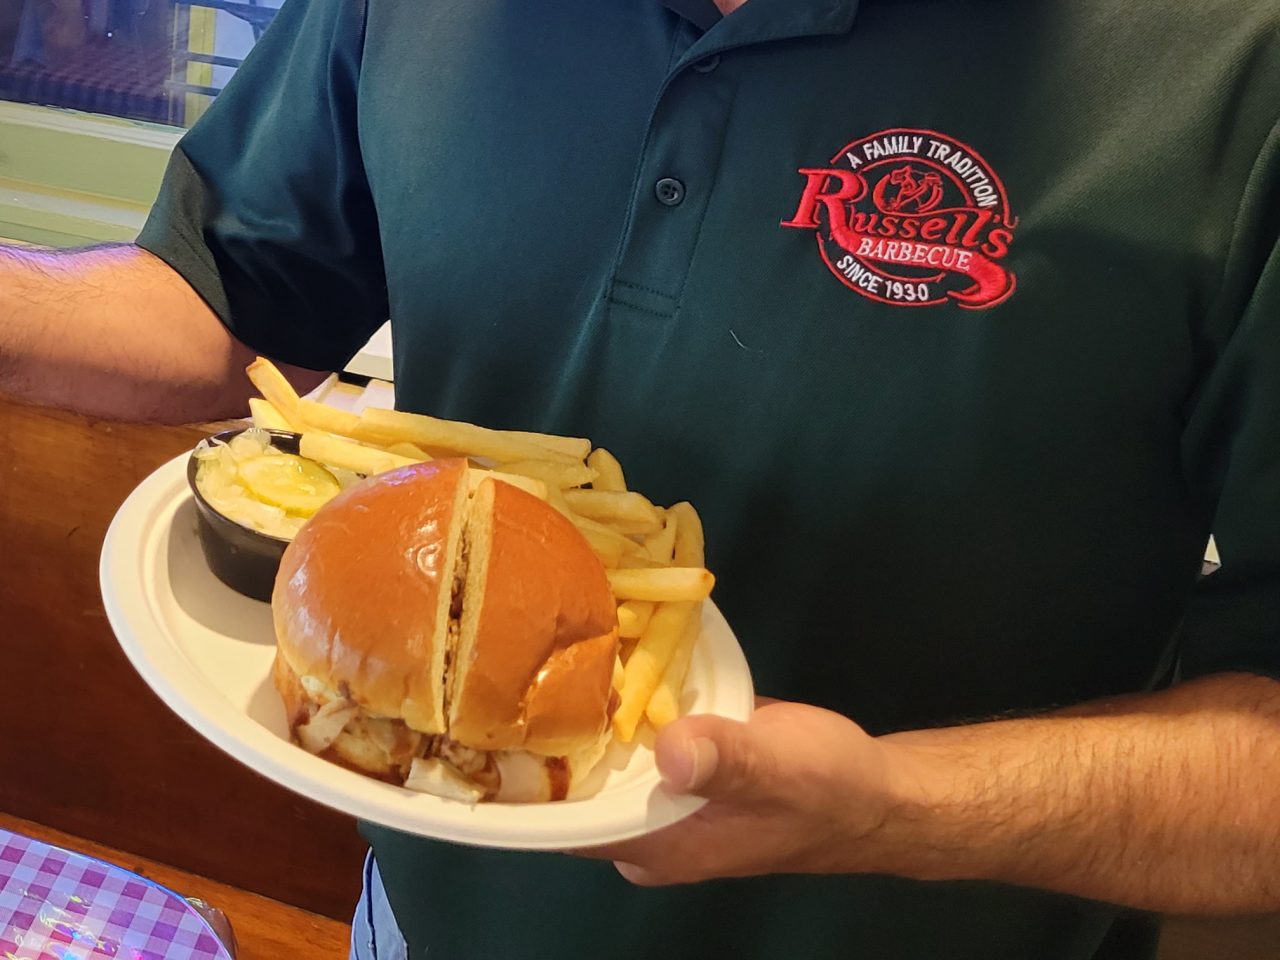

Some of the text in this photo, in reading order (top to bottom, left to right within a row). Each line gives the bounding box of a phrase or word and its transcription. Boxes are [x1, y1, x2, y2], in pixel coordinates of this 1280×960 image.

[846, 135, 999, 208] A FAMILY TRADITION
[779, 166, 1014, 262] Russell's
[836, 254, 929, 301] SINCE 1930
[855, 237, 973, 272] BARBECUE
